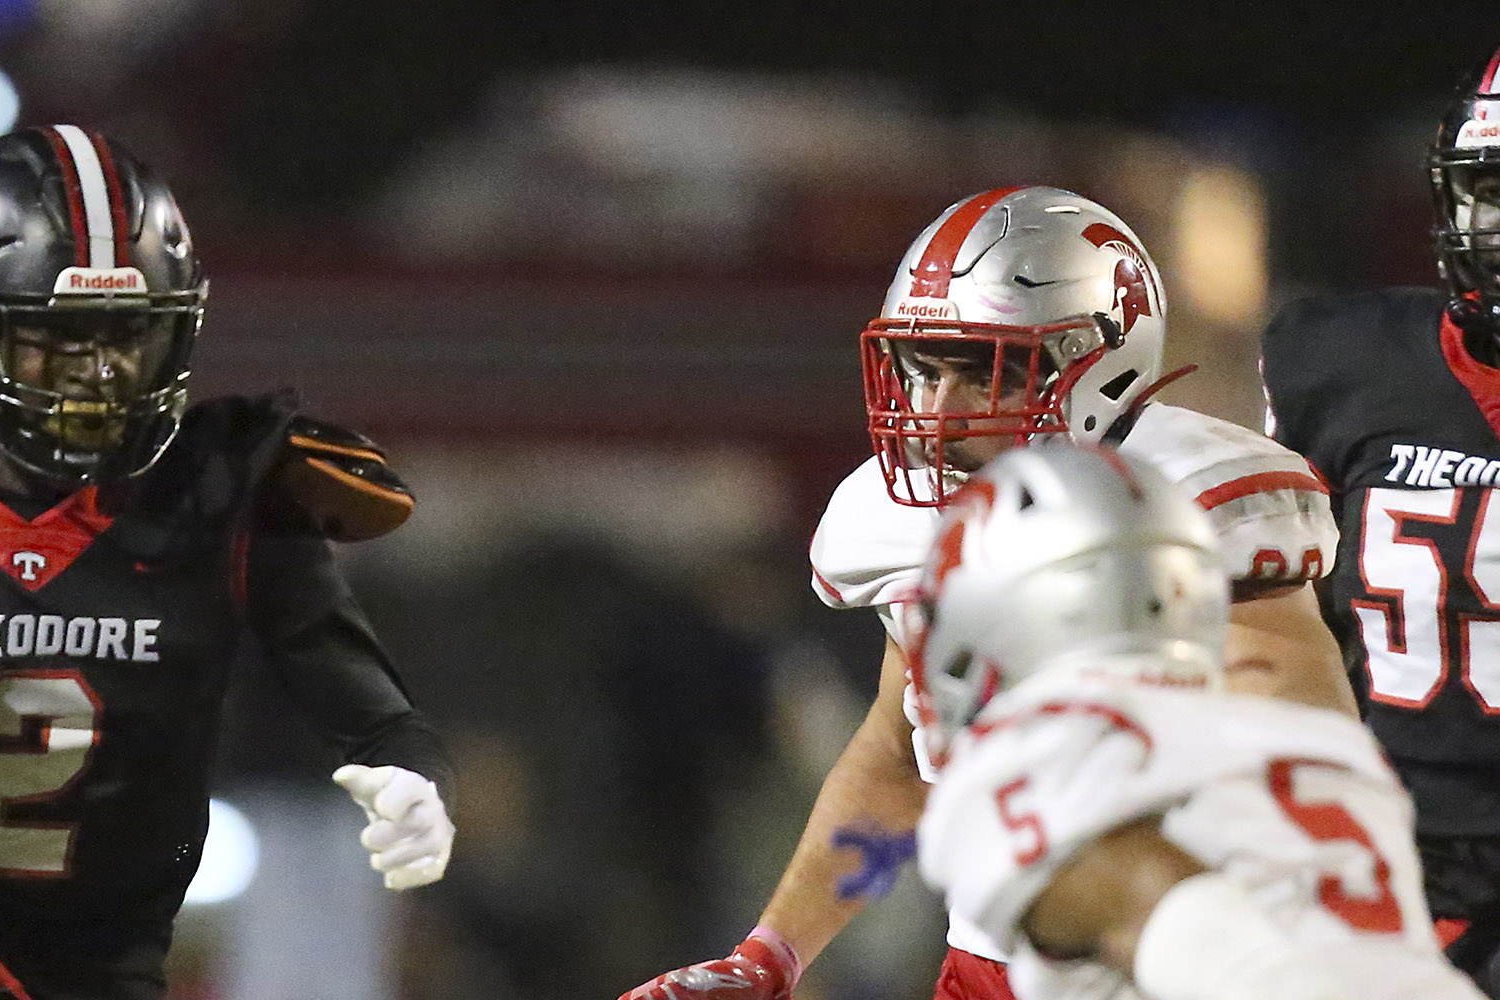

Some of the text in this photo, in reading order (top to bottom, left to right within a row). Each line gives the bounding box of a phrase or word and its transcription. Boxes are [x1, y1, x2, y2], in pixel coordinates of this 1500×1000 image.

[70, 274, 137, 289] Riddell
[898, 302, 949, 318] Riddell
[13, 551, 46, 581] T
[995, 776, 1049, 867] 5
[1264, 756, 1405, 933] 5
